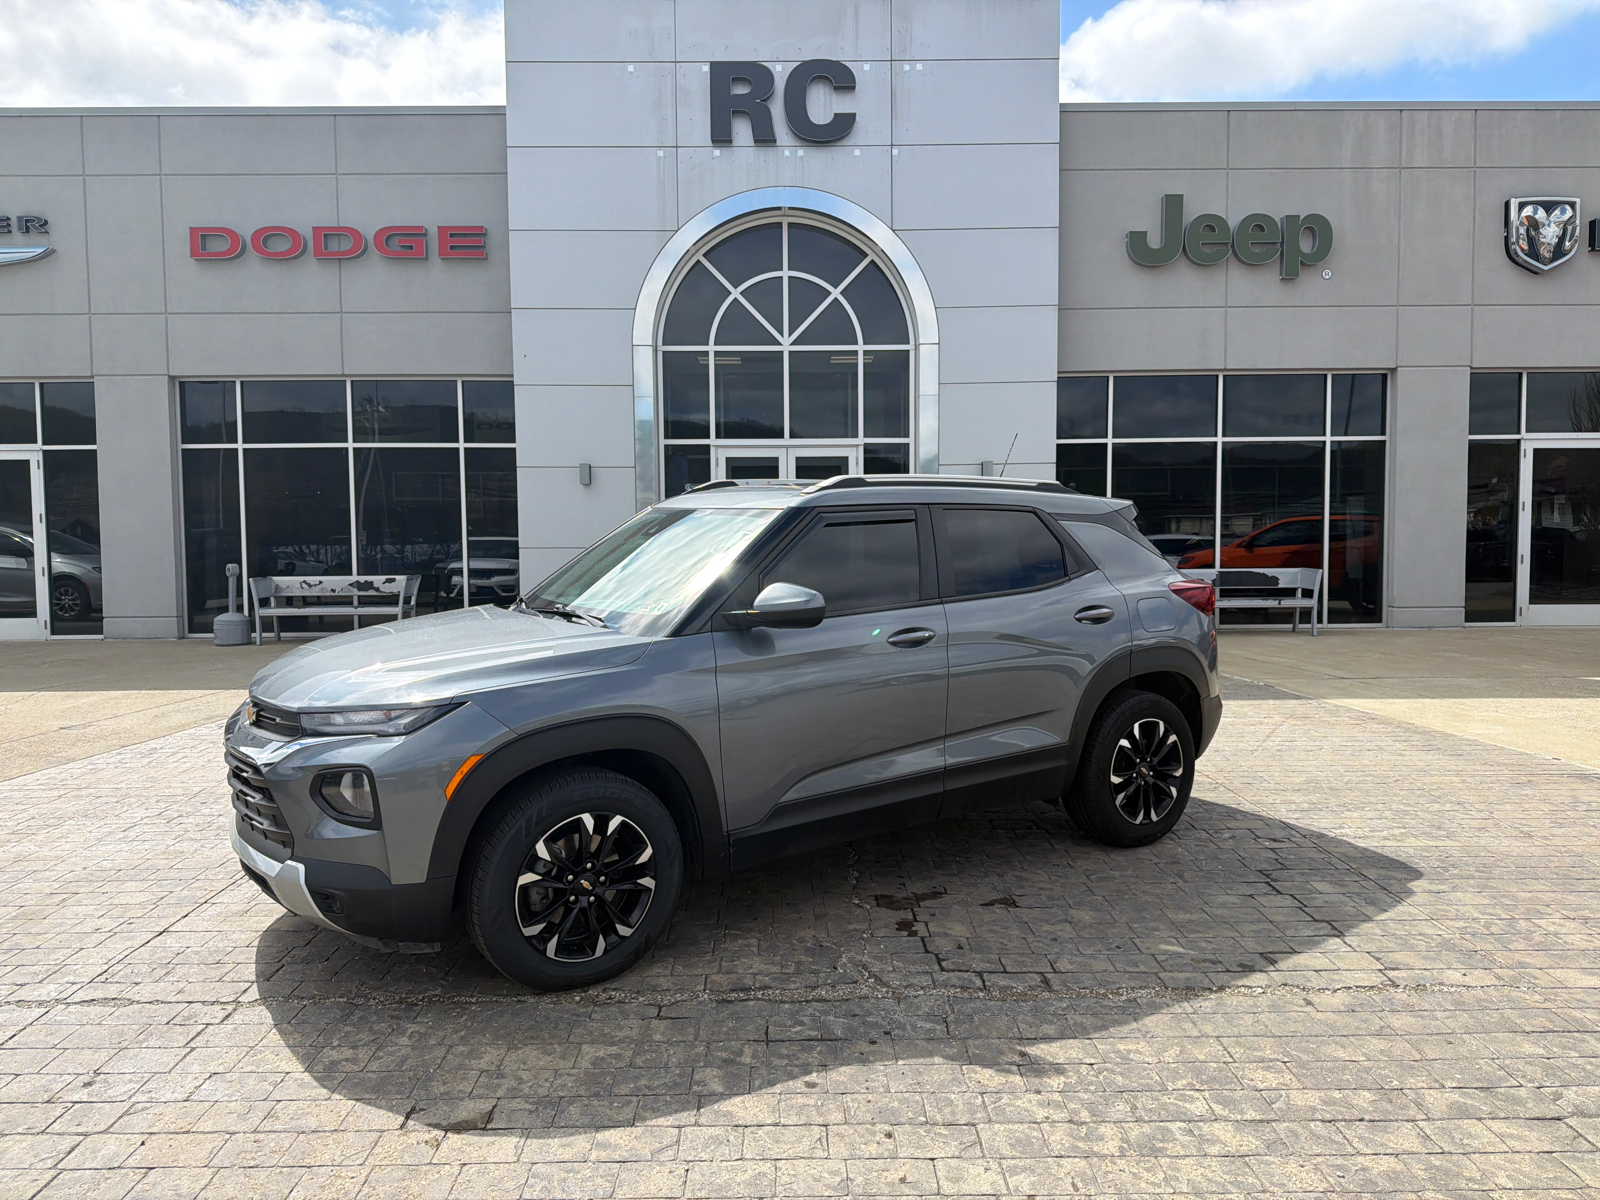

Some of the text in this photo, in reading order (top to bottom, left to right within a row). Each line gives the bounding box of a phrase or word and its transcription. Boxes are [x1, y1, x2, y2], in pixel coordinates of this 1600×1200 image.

[709, 58, 857, 144] RC
[189, 225, 488, 261] DODGE
[1126, 193, 1334, 280] Jeep
